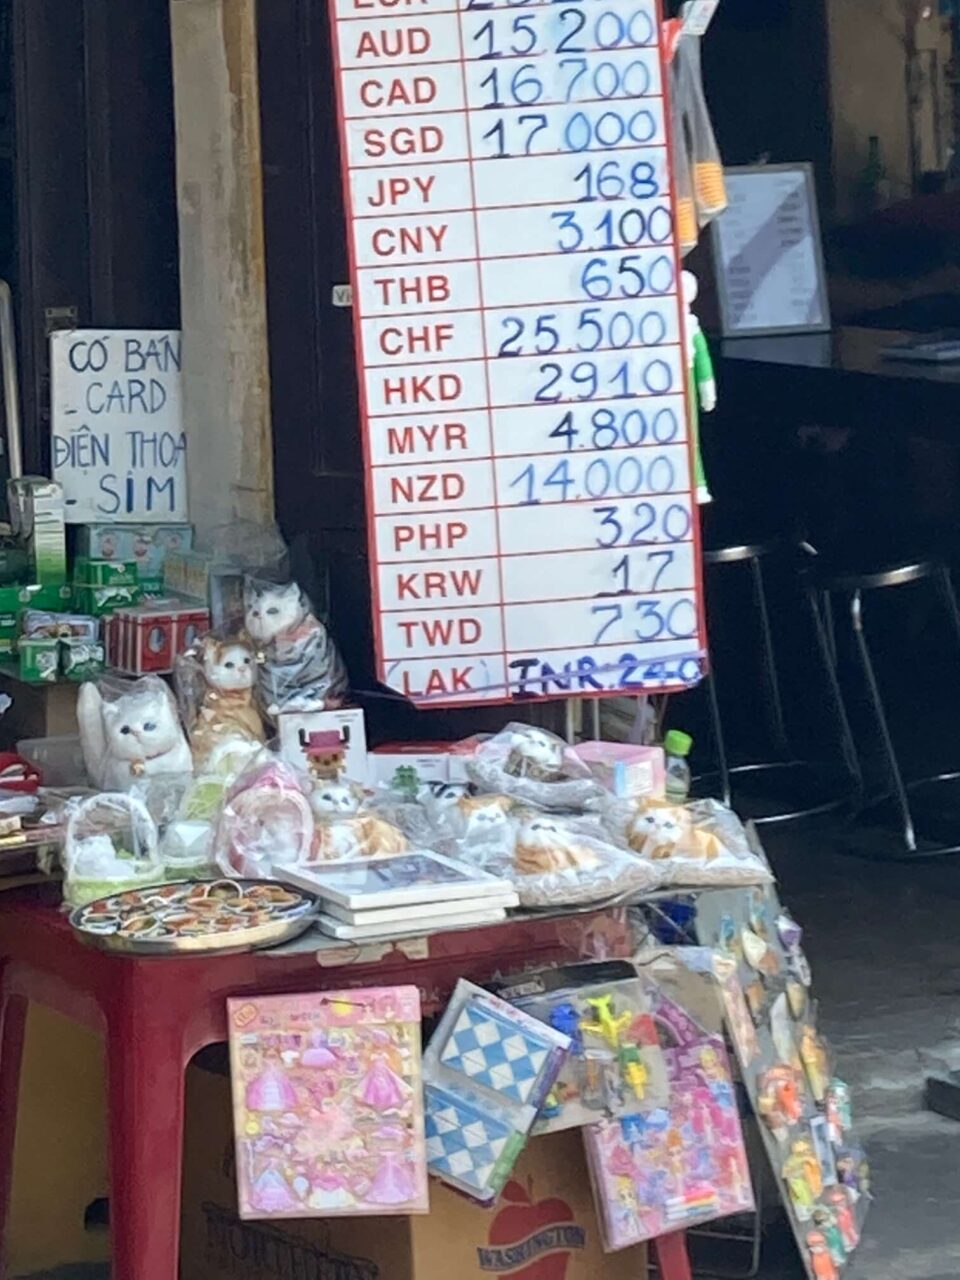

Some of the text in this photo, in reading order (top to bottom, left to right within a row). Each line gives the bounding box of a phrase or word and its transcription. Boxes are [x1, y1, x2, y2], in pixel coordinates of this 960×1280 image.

[356, 28, 431, 58] AUD
[359, 77, 437, 107] CAD
[363, 126, 444, 158] SGD
[368, 161, 659, 208] JPY 168
[371, 225, 449, 257] CNY
[374, 255, 674, 305] THB 650
[379, 324, 455, 356] CHF
[86, 378, 167, 414] CARD
[383, 373, 463, 404] HKD
[387, 423, 468, 455] MYR
[390, 473, 466, 505] NZD
[394, 522, 468, 552] PHP
[397, 550, 674, 600] KRW 17
[398, 598, 698, 649] TWD 730
